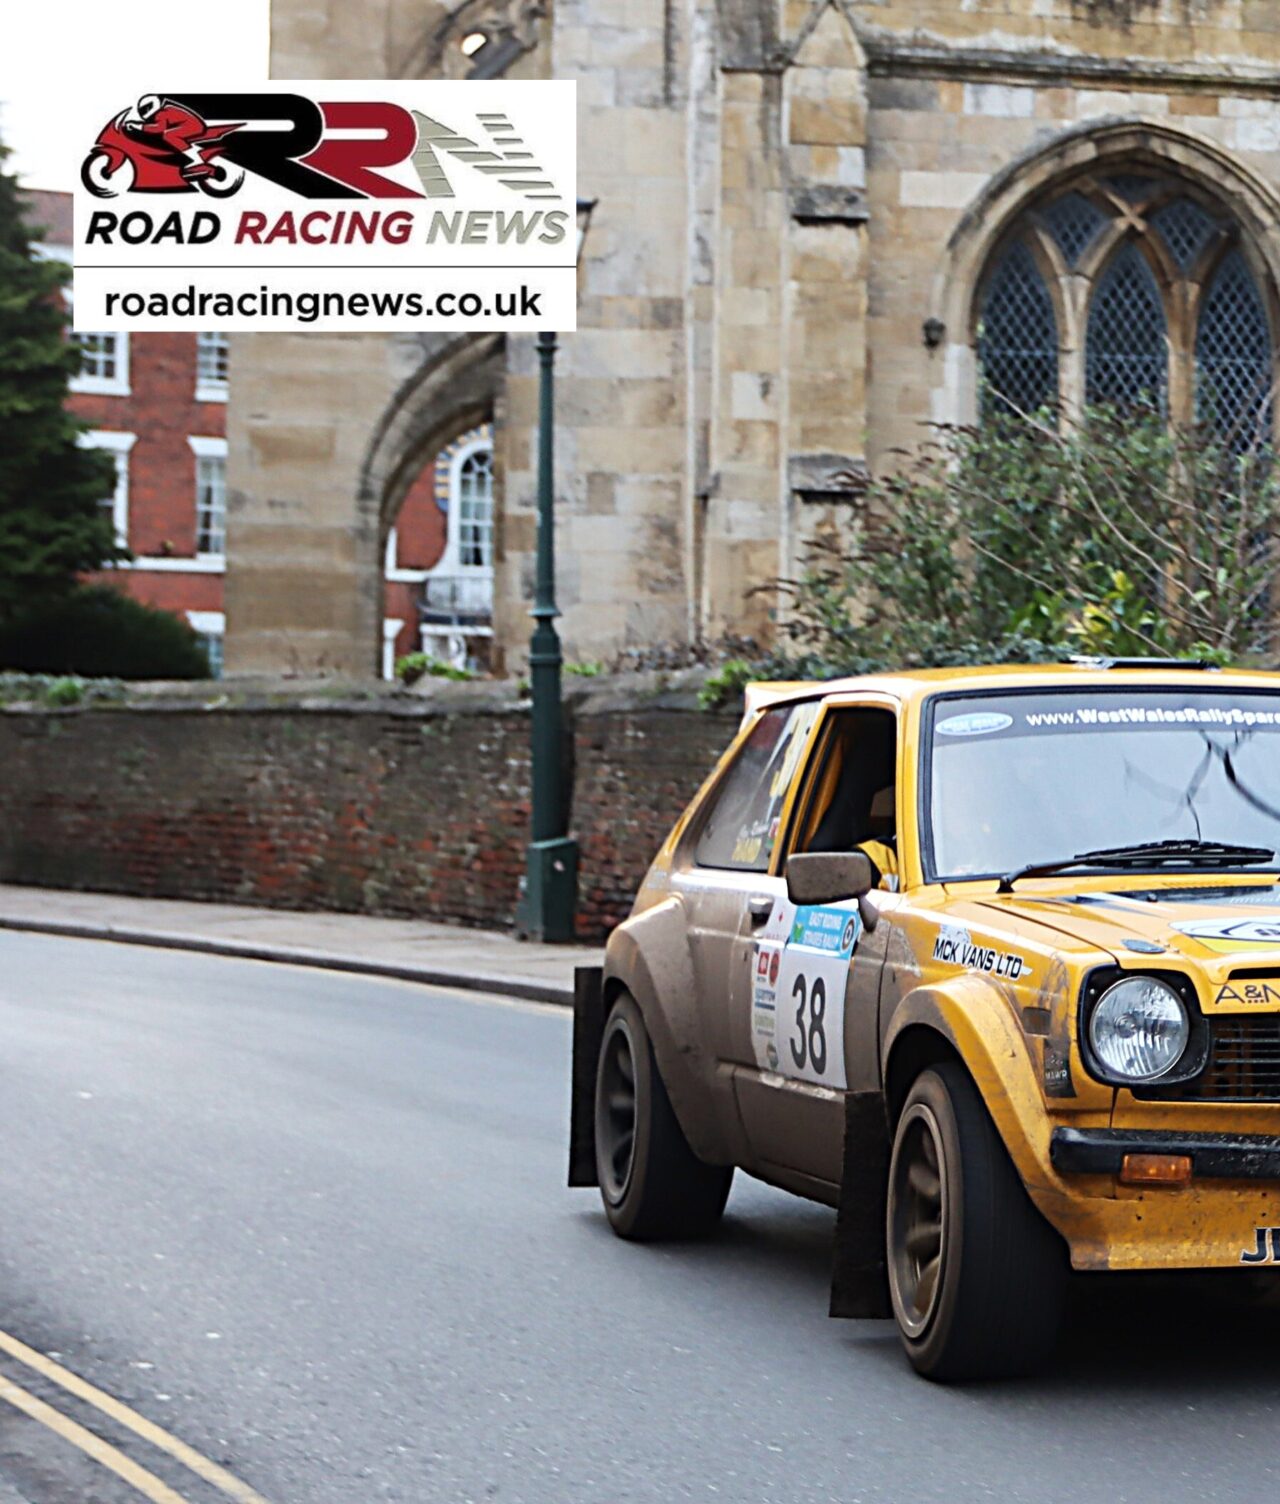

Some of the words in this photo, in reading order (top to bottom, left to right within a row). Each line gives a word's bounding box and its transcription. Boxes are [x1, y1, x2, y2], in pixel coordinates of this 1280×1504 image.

[932, 937, 960, 962] MCK
[961, 943, 996, 971] VANS
[996, 953, 1023, 979] LTD
[790, 972, 827, 1076] 38
